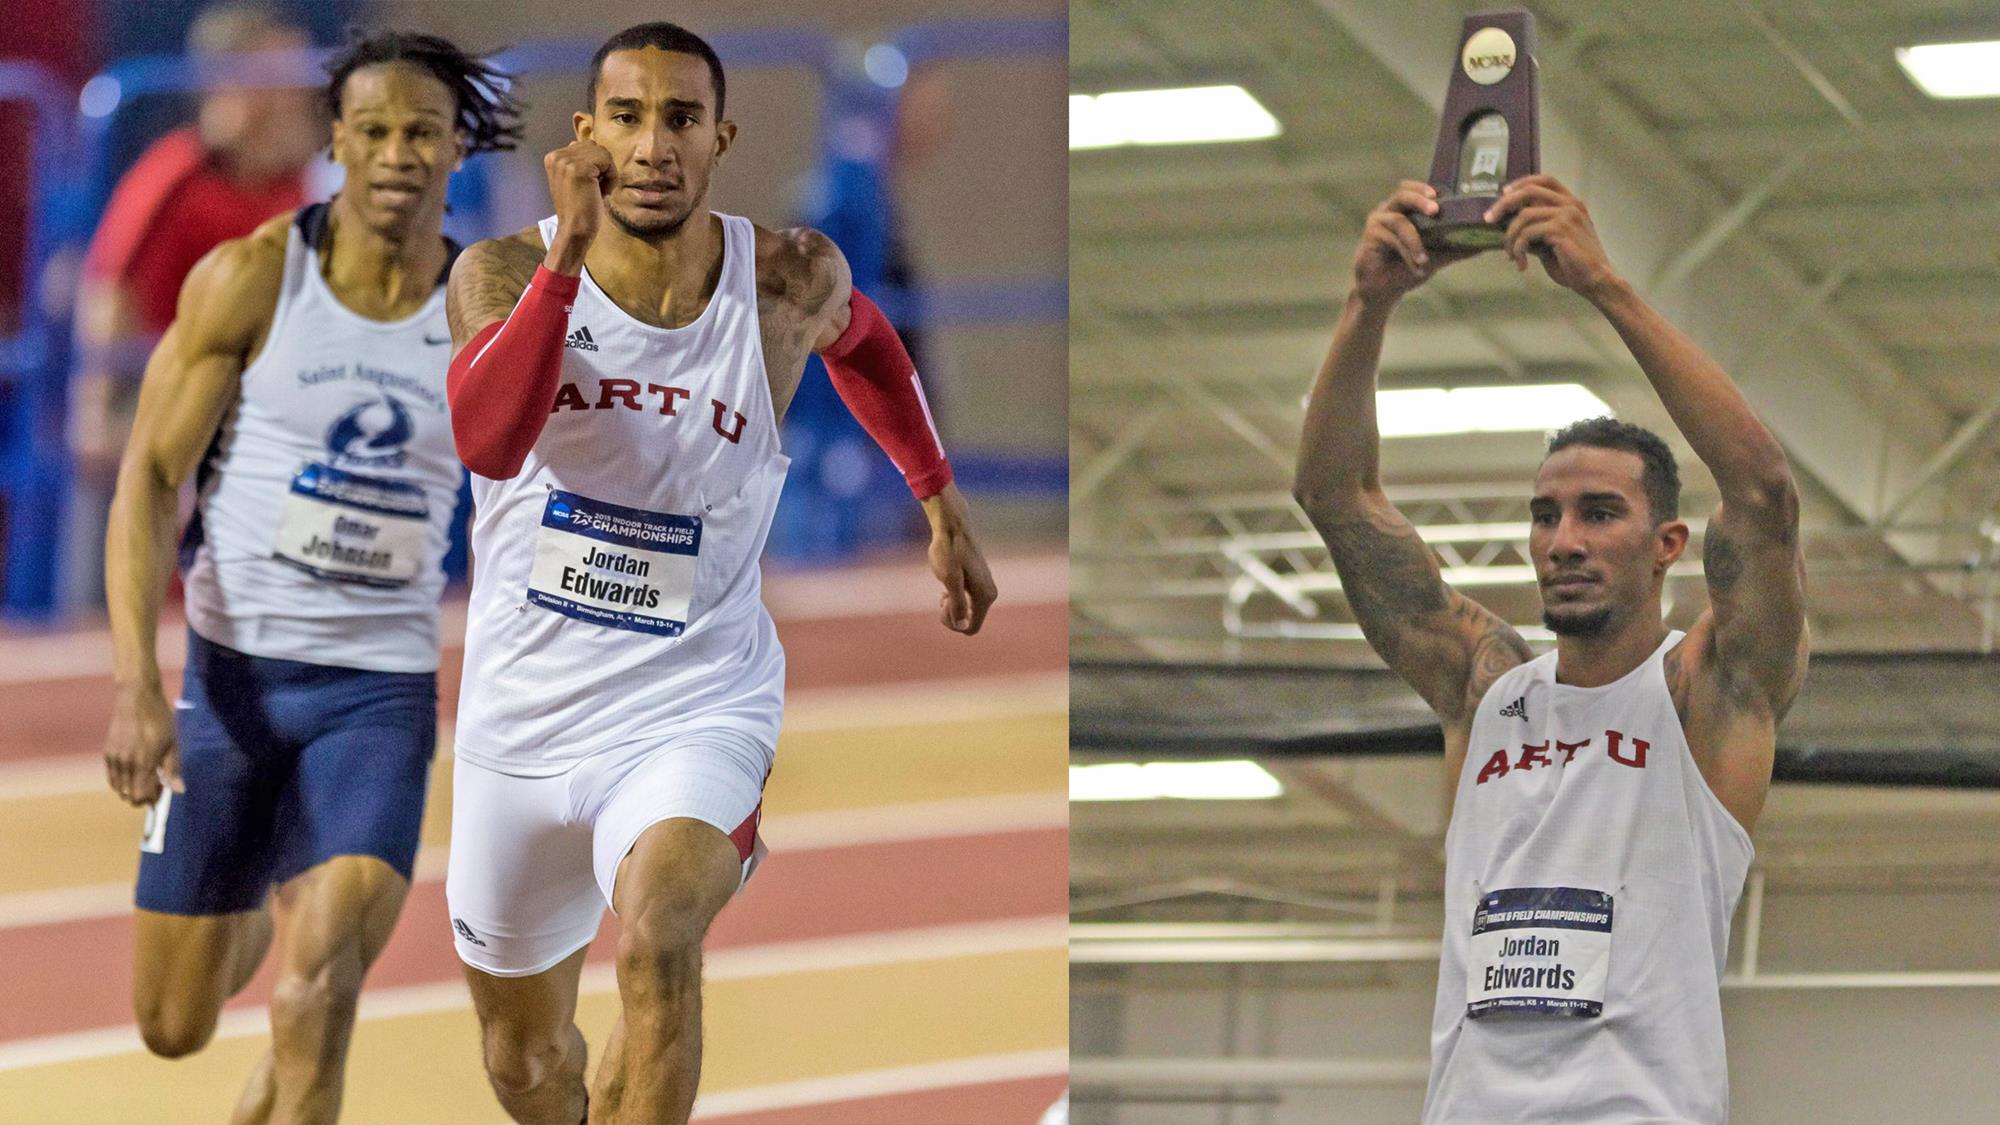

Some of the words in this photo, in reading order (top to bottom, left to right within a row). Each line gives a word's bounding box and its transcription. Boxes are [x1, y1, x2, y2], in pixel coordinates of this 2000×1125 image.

[1467, 54, 1514, 70] NCAA
[563, 339, 600, 352] adidas
[298, 364, 346, 387] Saint
[549, 378, 690, 417] ART
[710, 398, 748, 445] U
[591, 519, 694, 546] CHAMPIONSHIPS
[612, 516, 642, 528] INDOOR
[643, 522, 668, 532] TRACK
[674, 527, 695, 536] FIELD
[303, 534, 393, 571] Johnson
[583, 546, 651, 578] Jordan
[560, 566, 661, 609] Edwards
[538, 594, 562, 606] Division
[634, 616, 655, 627] March
[1605, 729, 1651, 769] U
[1512, 910, 1534, 921] FIELD
[1534, 909, 1609, 924] CHAMPIONSHIPS
[1498, 935, 1560, 958] Jordan
[1484, 963, 1576, 991] Edwards
[1546, 1000, 1568, 1008] March
